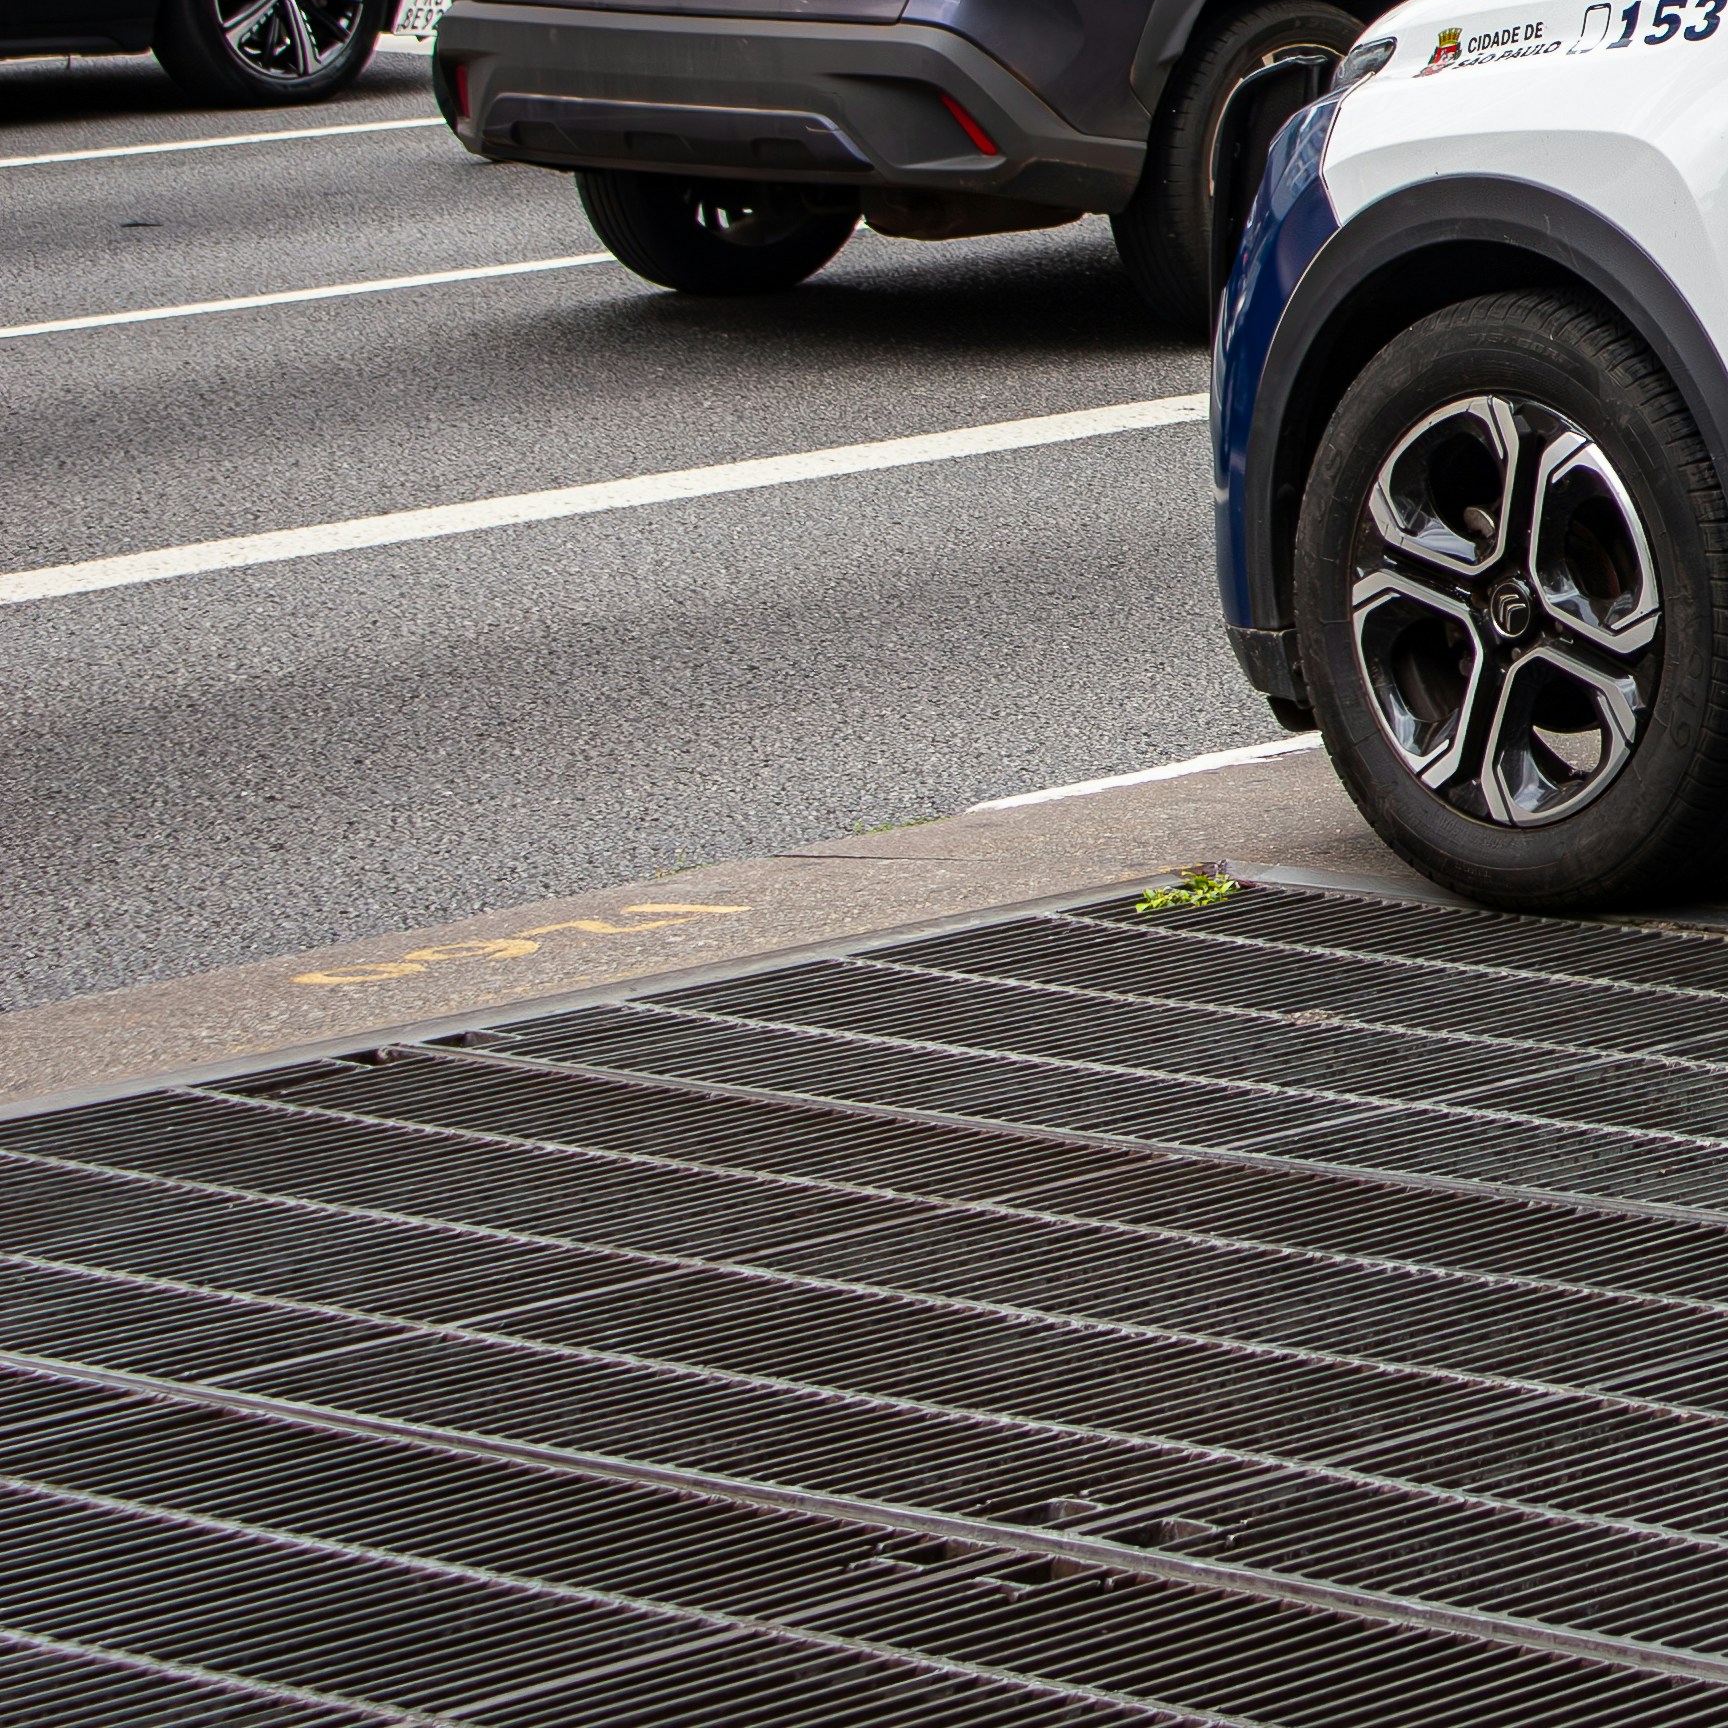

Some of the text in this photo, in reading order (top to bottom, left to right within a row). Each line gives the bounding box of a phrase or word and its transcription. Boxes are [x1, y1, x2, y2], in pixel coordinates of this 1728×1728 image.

[1467, 22, 1544, 54] CIDADE DE
[1495, 40, 1563, 62] PAULO
